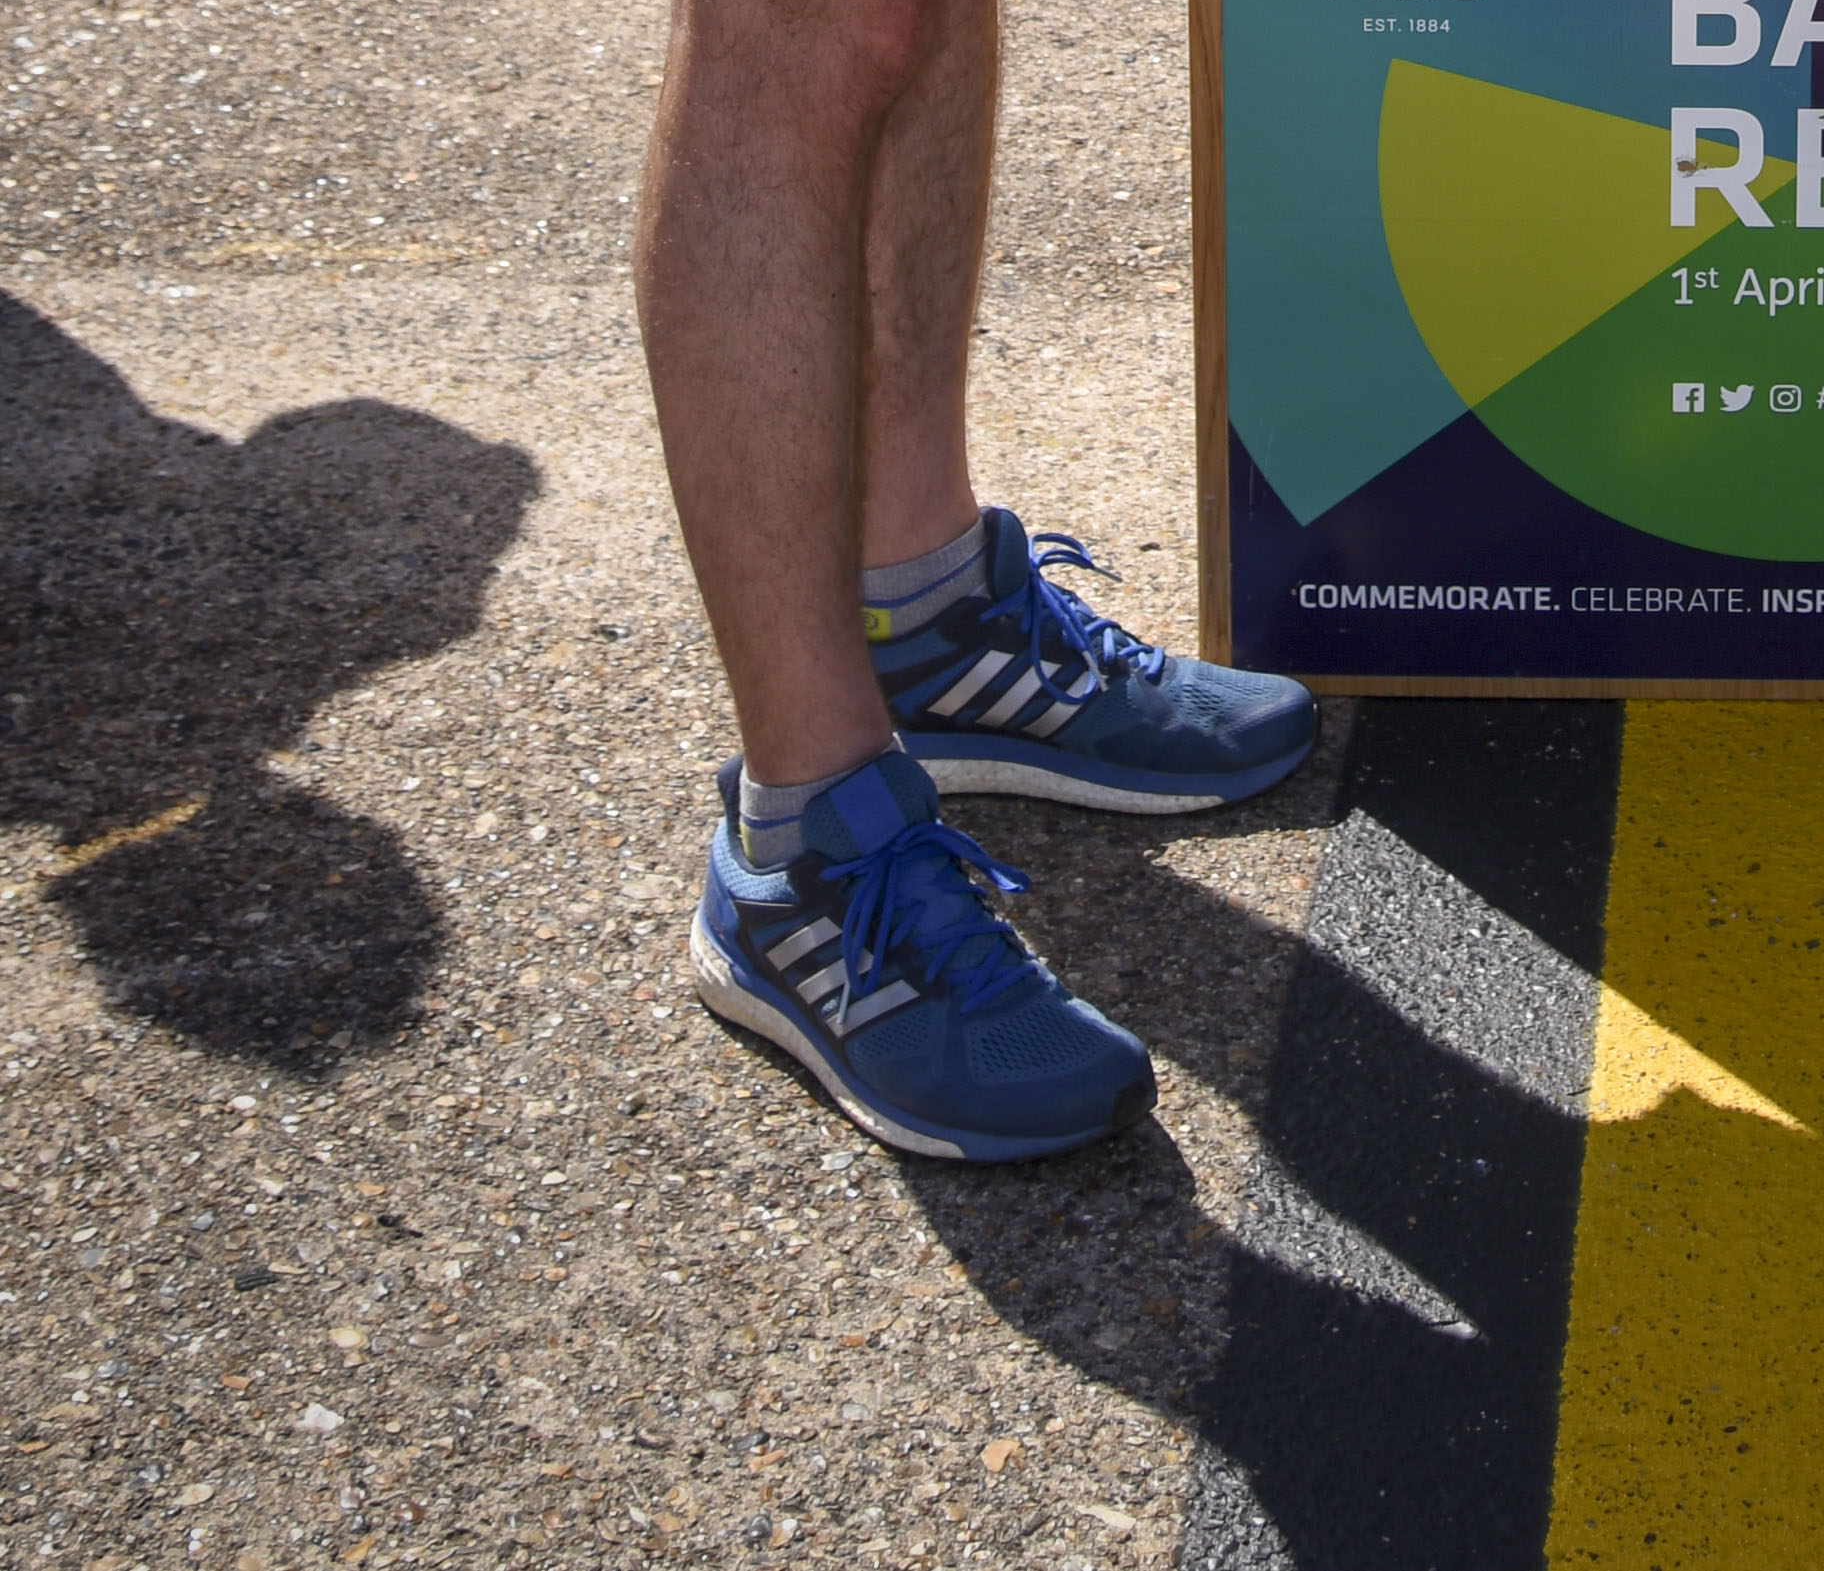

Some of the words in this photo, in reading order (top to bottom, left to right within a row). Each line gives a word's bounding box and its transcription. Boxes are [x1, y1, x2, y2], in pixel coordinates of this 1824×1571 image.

[1363, 18, 1402, 33] EST.
[1408, 18, 1450, 34] 1884
[1671, 266, 1719, 306] 1st
[1299, 583, 1561, 611] COMMEMORATE.
[1571, 586, 1752, 613] CELEBRATE.
